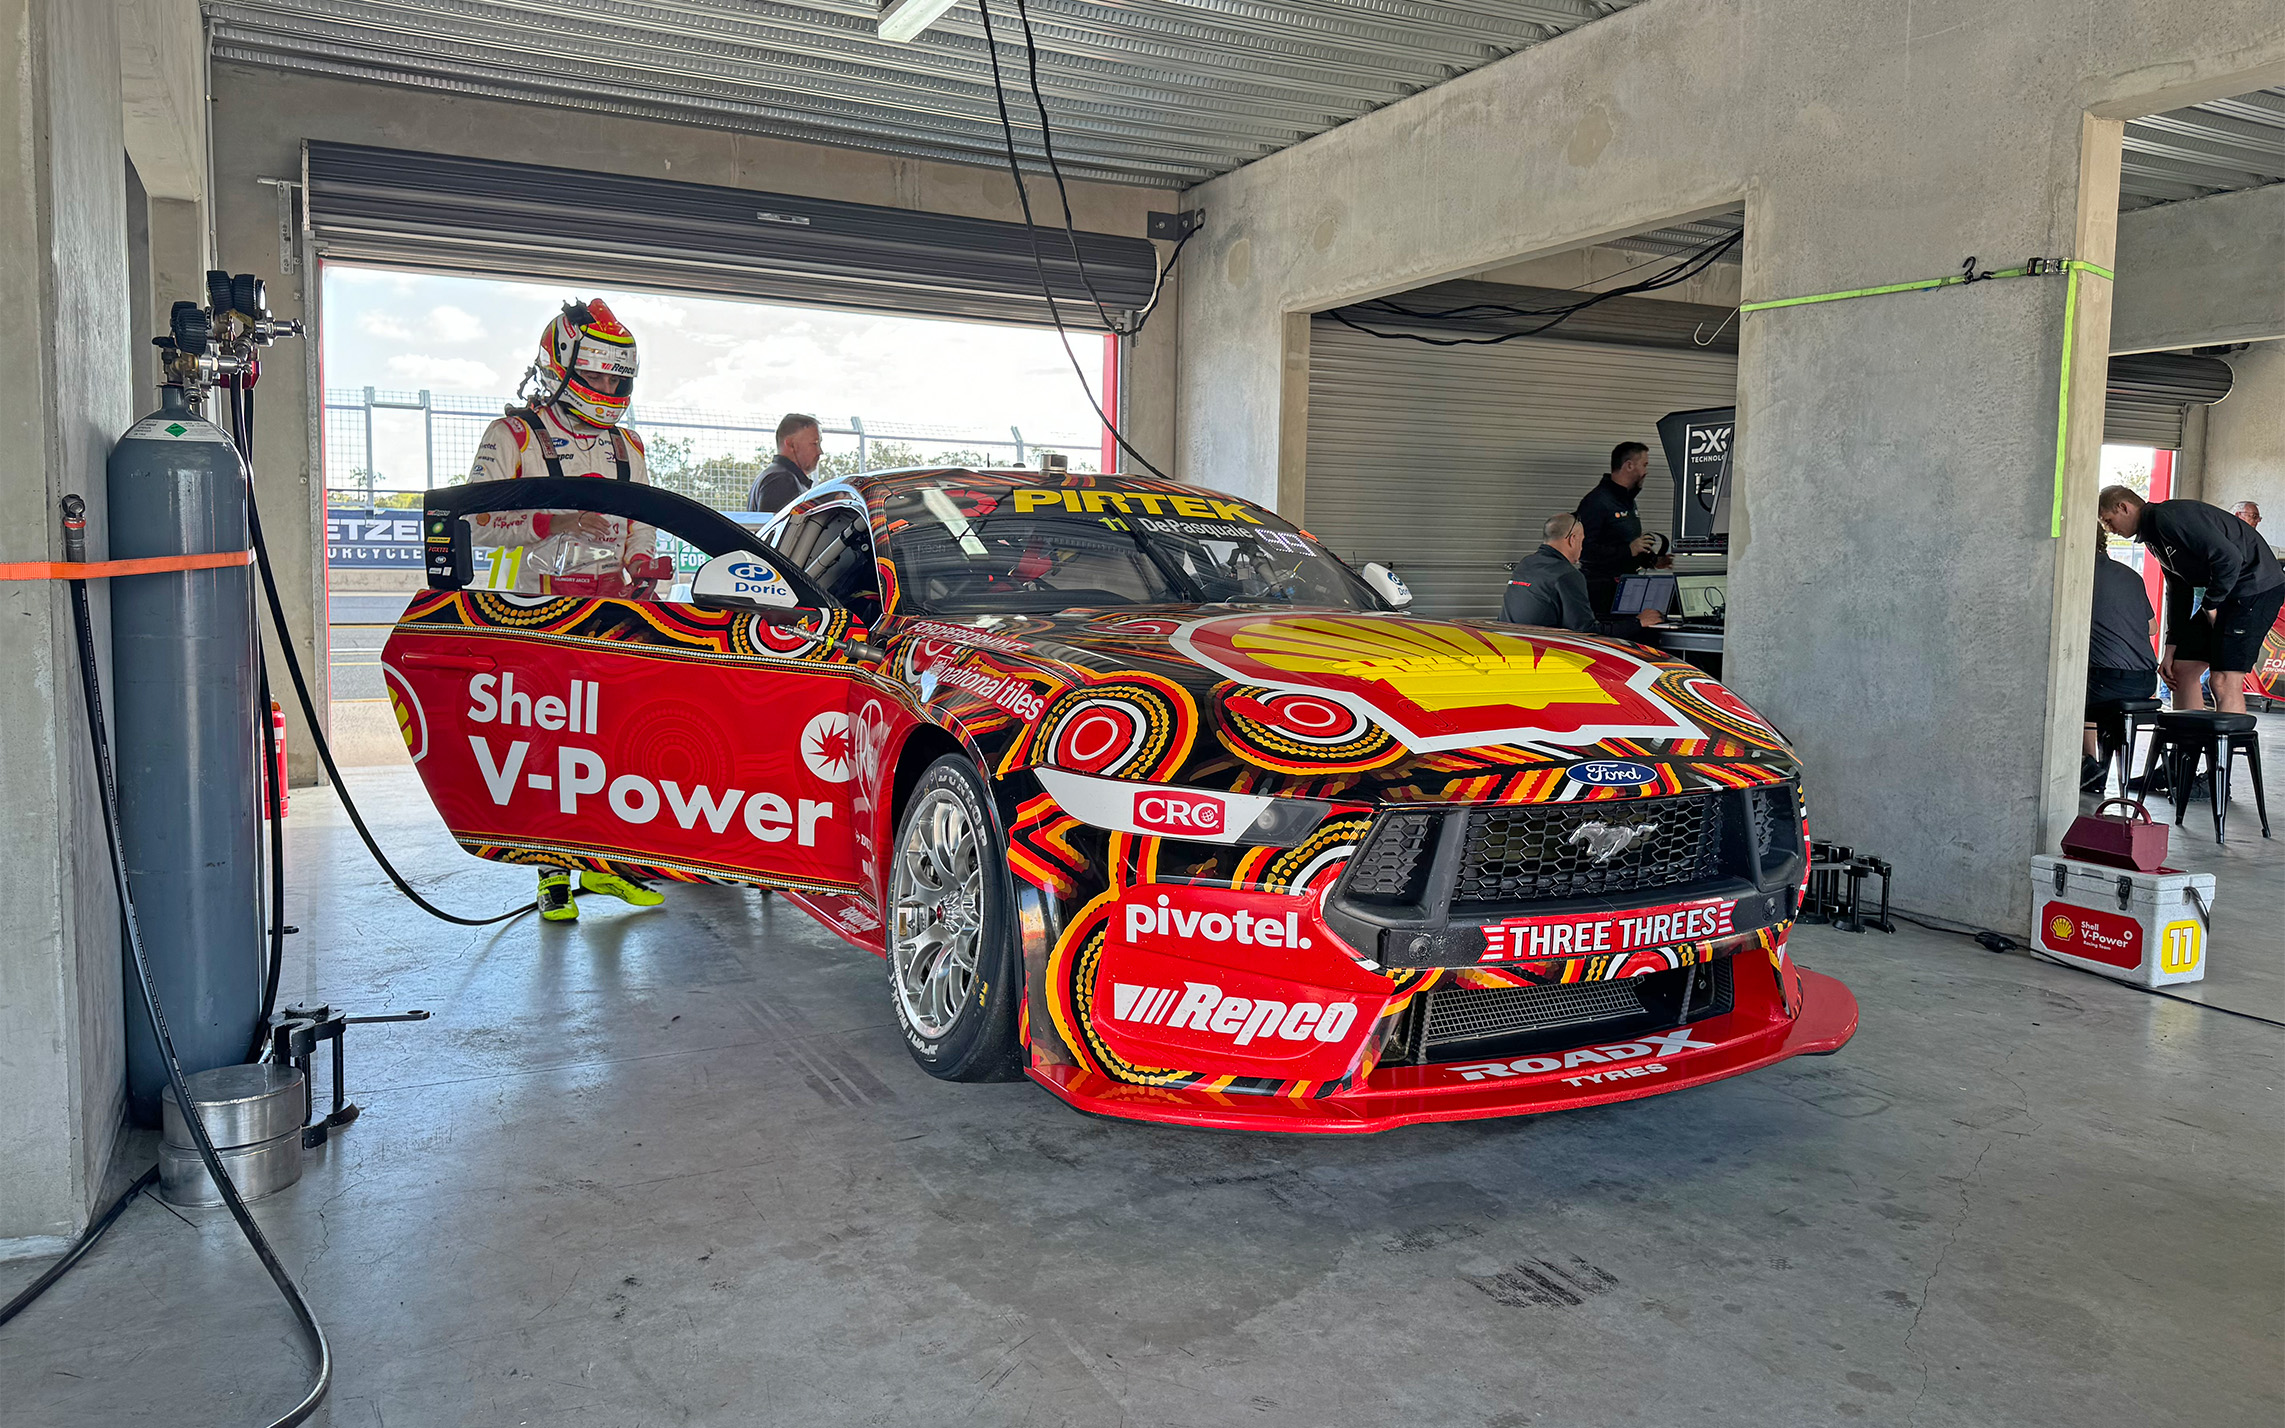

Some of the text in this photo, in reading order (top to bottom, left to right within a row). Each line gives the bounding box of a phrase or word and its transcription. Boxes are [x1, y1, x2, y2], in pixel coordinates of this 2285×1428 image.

[611, 362, 636, 375] Repco
[1013, 489, 1264, 525] PIRTEK
[327, 518, 424, 542] ETZE
[1098, 517, 1131, 531] 11
[1138, 517, 1254, 538] DePasquale
[487, 546, 524, 590] 11
[735, 582, 787, 596] Doric
[467, 671, 600, 735] Shell
[1585, 763, 1642, 782] Ford
[467, 735, 834, 847] V-Power
[938, 766, 988, 847] DUNLOP
[1138, 797, 1219, 830] CRC
[1125, 894, 1312, 949] pivotel.
[1508, 906, 1719, 957] THREE THREES
[2081, 920, 2099, 932] Shell
[2081, 928, 2129, 948] V-Power
[2083, 940, 2111, 951] Racing Team
[2169, 926, 2194, 966] 11
[1166, 981, 1358, 1046] Repco
[1445, 1028, 1717, 1082] ROADX
[1561, 1063, 1668, 1088] TYRES
